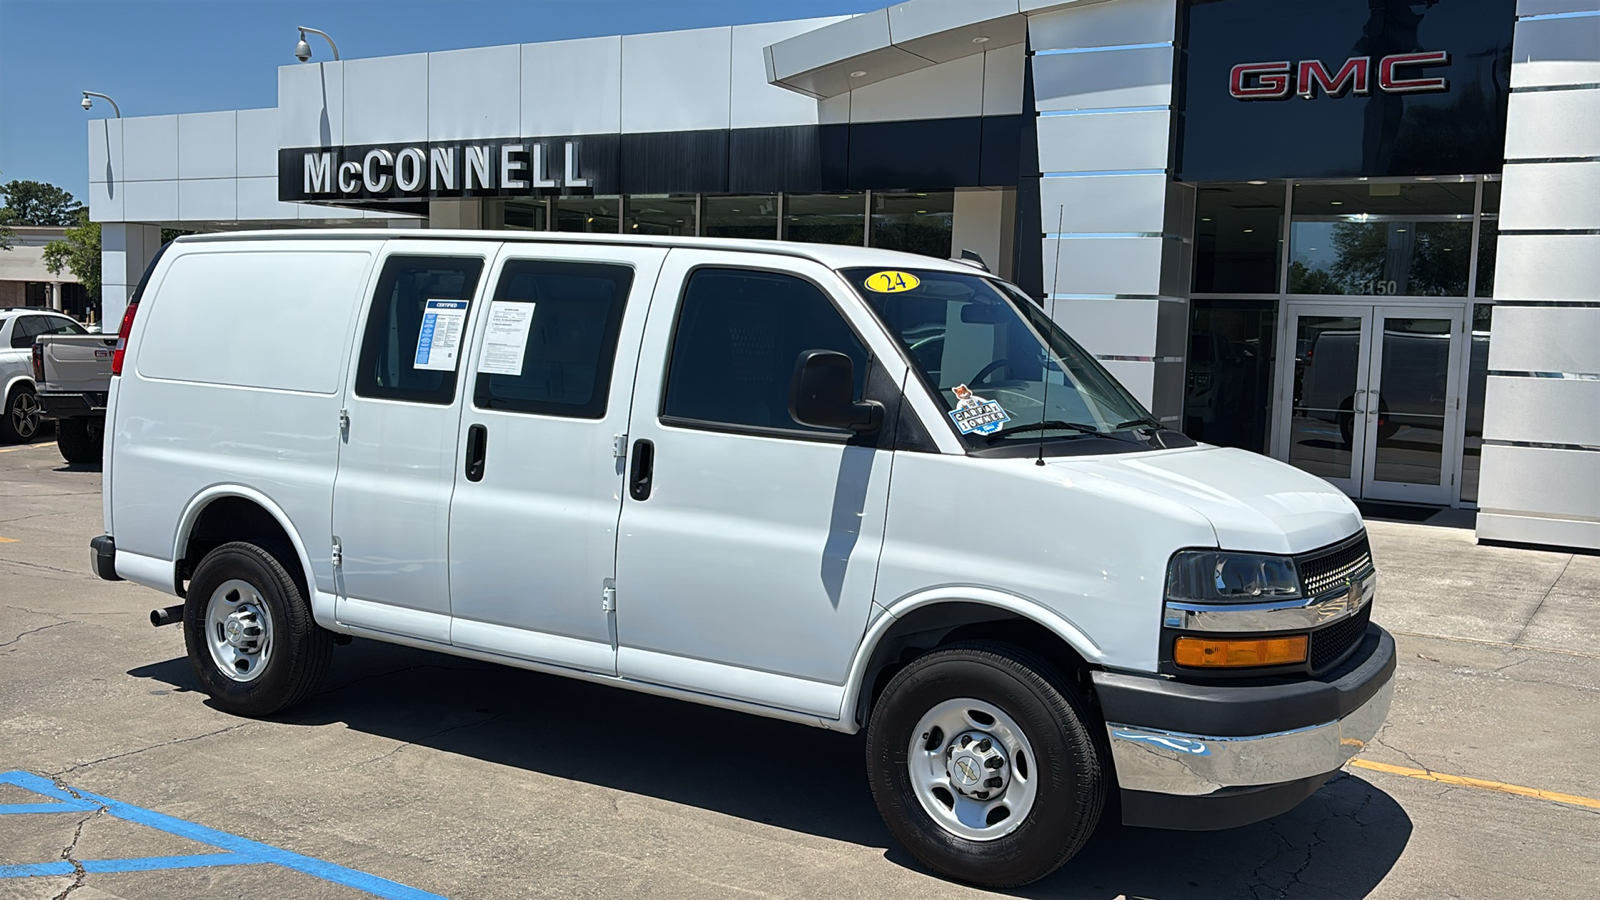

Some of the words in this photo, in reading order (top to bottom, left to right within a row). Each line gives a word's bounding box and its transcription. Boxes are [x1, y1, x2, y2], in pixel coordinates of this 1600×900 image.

[1229, 50, 1449, 99] GMC
[303, 141, 592, 194] McCONNELL
[880, 272, 906, 291] 24
[1355, 280, 1397, 295] 3150
[954, 404, 1000, 421] CARFAX
[962, 422, 969, 430] 1
[968, 411, 1005, 428] OWNER
